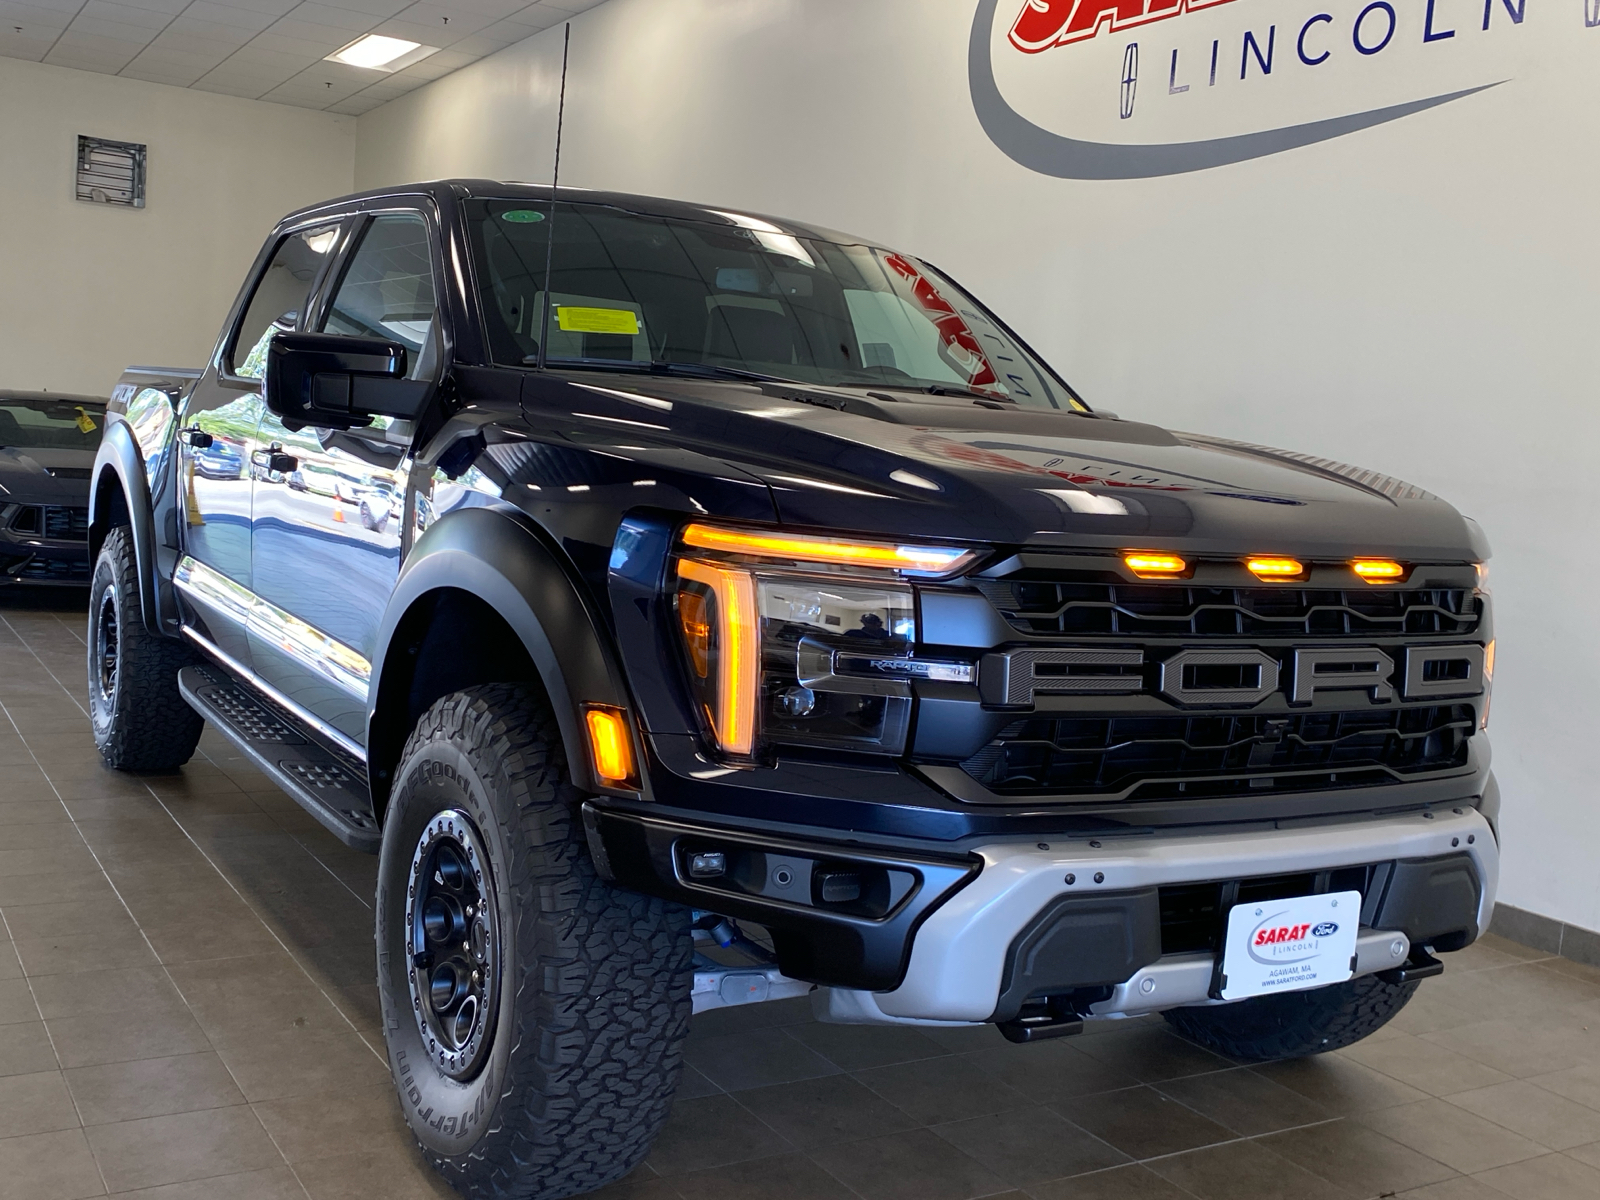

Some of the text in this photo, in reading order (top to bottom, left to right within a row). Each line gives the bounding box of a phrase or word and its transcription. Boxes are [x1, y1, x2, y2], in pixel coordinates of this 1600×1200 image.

[1168, 0, 1526, 95] LINCOLN
[982, 644, 1486, 707] FORD
[1254, 922, 1336, 947] SARAT Ford
[1278, 942, 1313, 954] LINCOLN
[1261, 973, 1317, 987] WWW.SARATFORD.COM
[1269, 965, 1312, 978] AGAWAM, MA
